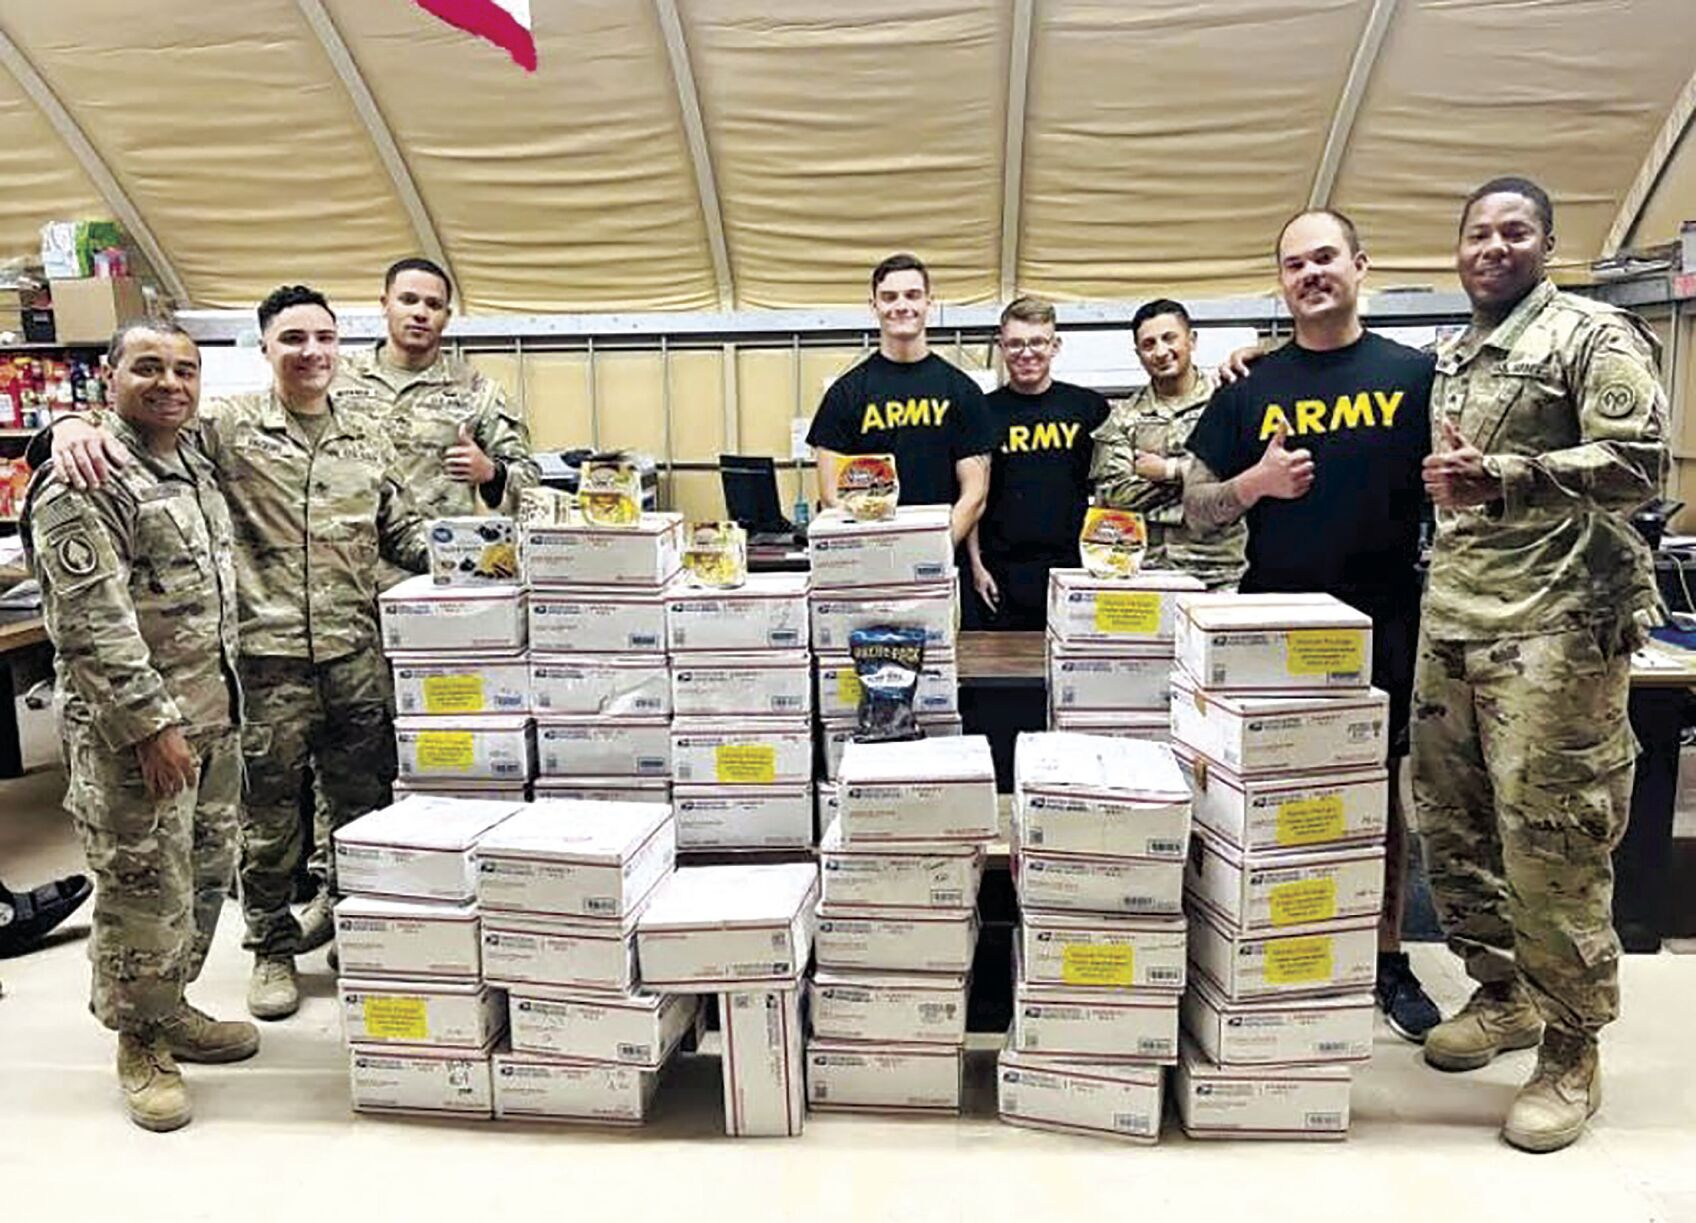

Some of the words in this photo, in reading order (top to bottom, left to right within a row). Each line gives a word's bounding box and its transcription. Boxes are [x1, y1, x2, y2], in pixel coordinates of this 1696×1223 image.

[861, 398, 950, 434] ARMY
[1259, 391, 1405, 441] ARMY
[1000, 422, 1081, 454] RMY
